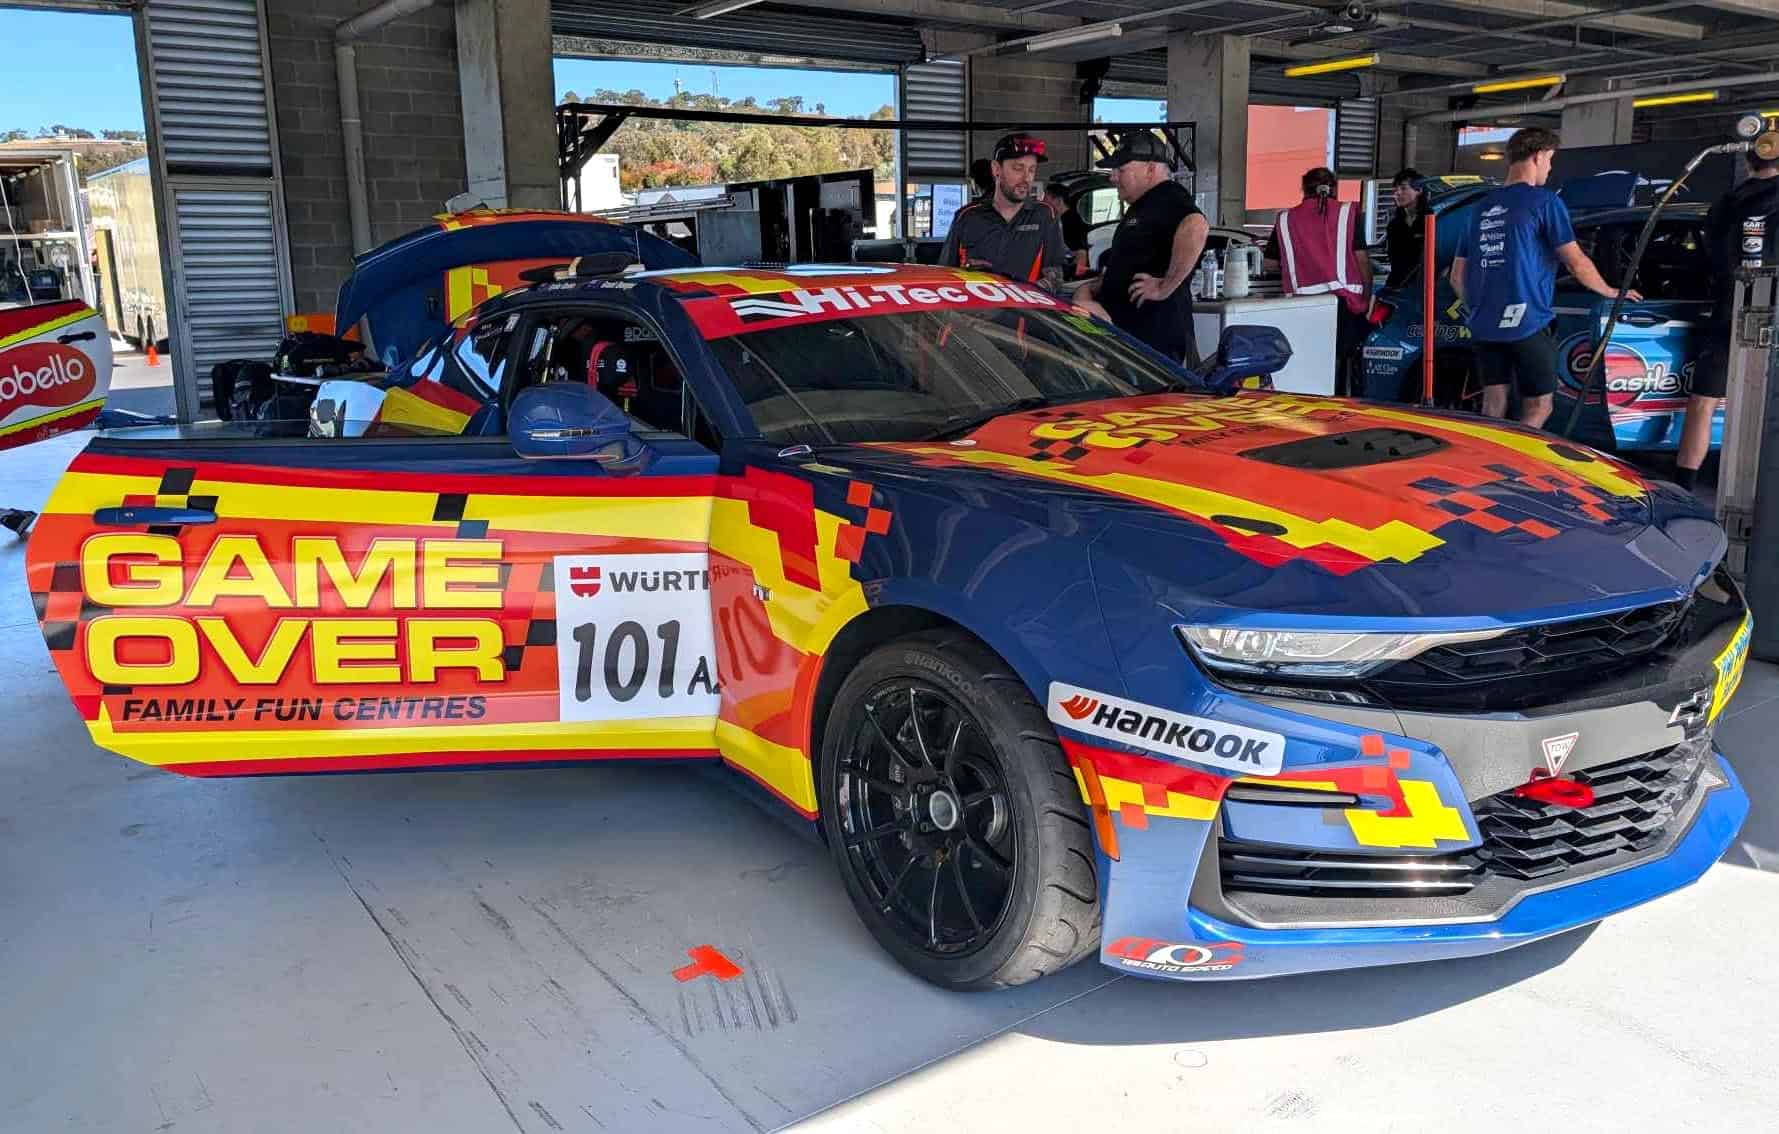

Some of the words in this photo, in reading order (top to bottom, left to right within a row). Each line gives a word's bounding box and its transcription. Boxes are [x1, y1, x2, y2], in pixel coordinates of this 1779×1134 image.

[793, 284, 970, 315] Hi-Tec
[964, 281, 1057, 306] Oils
[1499, 303, 1527, 328] 9
[1030, 396, 1273, 434] GAME
[80, 532, 506, 609] GAME
[85, 614, 506, 687] OVER
[573, 619, 681, 703] 101
[122, 697, 245, 722] FAMILY
[253, 697, 322, 721] FUN
[333, 695, 488, 720] CENTRES
[1551, 739, 1574, 752] TOW
